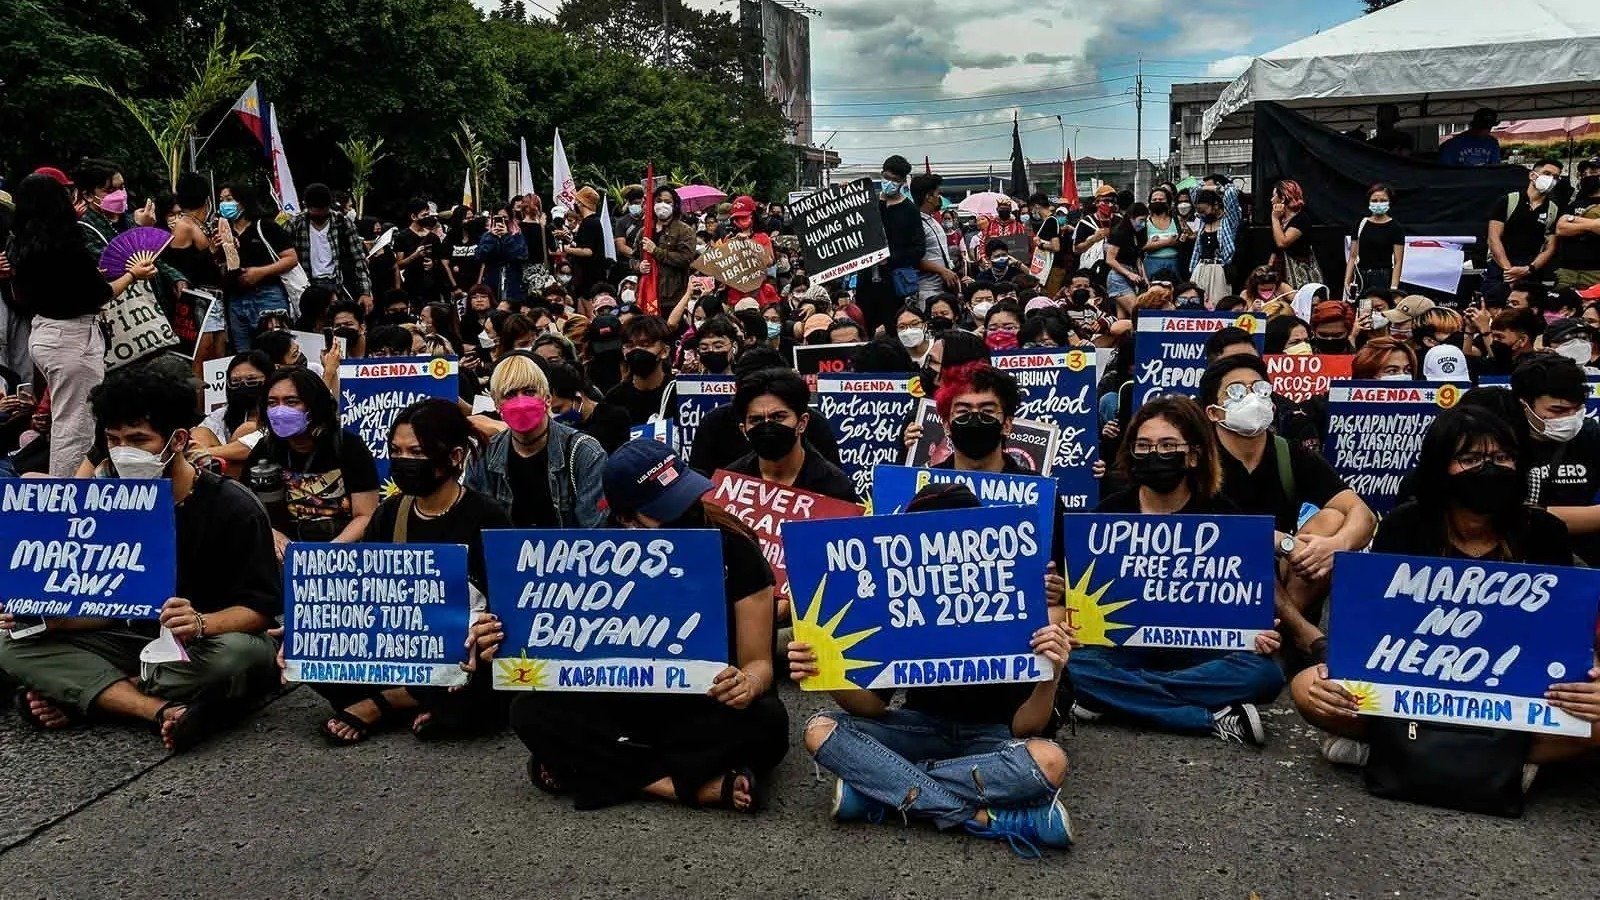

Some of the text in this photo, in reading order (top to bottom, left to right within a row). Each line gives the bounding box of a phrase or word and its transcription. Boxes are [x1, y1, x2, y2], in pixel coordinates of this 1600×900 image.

[791, 180, 864, 217] MARTIAL LAW
[806, 190, 870, 227] ALALAHANIN!
[805, 211, 865, 246] HUWAG NA
[816, 231, 864, 259] ULITIN!
[1166, 319, 1224, 331] AGENDA
[360, 364, 418, 377] AGENDA
[999, 356, 1054, 368] AGENDA
[1266, 356, 1321, 374] NO TO
[704, 383, 737, 393] AGEN
[844, 381, 894, 391] AGENDA
[1352, 389, 1421, 401] AGENDA
[1007, 432, 1047, 446] os2022
[1060, 442, 1083, 455] SA
[1335, 433, 1356, 450] NG
[1335, 450, 1412, 470] PAGLABAN
[2, 483, 158, 514] NEVER AGAIN
[714, 475, 815, 518] NEVER
[1061, 495, 1087, 508] LIST
[67, 516, 97, 539] TO
[1088, 520, 1220, 555] UPHOLD
[10, 540, 145, 573] MARTIAL
[517, 539, 685, 578] MARCOS,
[826, 521, 1038, 572] NO TO MARCOS
[292, 549, 441, 577] MARCOS, DUTERTE,
[1120, 555, 1242, 580] FREE & FAIR
[44, 570, 125, 596] LAW!
[292, 577, 446, 604] WALANG PINAG-IBA!
[857, 559, 1016, 599] & DUTERTE
[1142, 579, 1262, 605] ELECTION!
[1383, 562, 1559, 613] MARCOS
[4, 599, 73, 615] KABATAAN
[517, 580, 635, 611] HINDI
[888, 590, 1028, 628] SA 2022!
[293, 604, 376, 630] PAREHONG
[1414, 604, 1483, 638] NO
[292, 632, 445, 659] DIKTADOR, PASISTA!
[528, 612, 701, 654] BAYANI!
[1143, 627, 1246, 648] KABATAAN PL
[301, 661, 433, 684] KABATAAN PARTYLIST
[893, 656, 1042, 685] KABATAAN PL
[1365, 633, 1521, 687] HERO!
[558, 666, 691, 688] KABATAAN PL
[1393, 690, 1561, 727] KABATAAN PL
